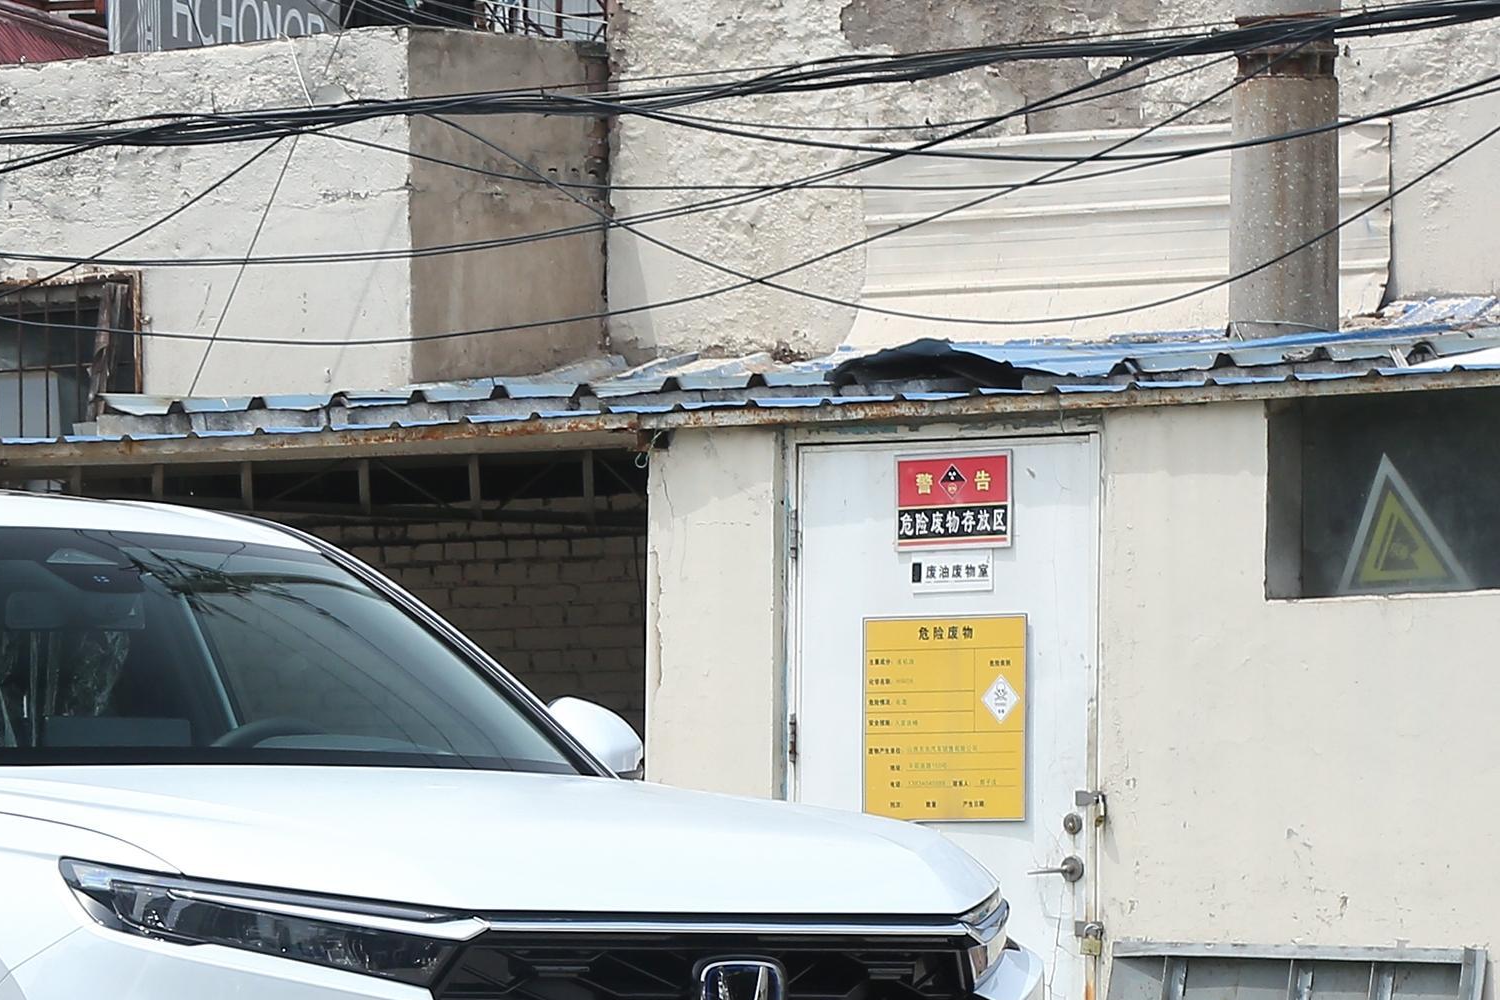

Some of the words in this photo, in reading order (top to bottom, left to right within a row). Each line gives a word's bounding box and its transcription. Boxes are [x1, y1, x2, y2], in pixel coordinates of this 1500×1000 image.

[900, 509, 1006, 536] 危险废物存放区
[918, 626, 974, 640] 危险废物
